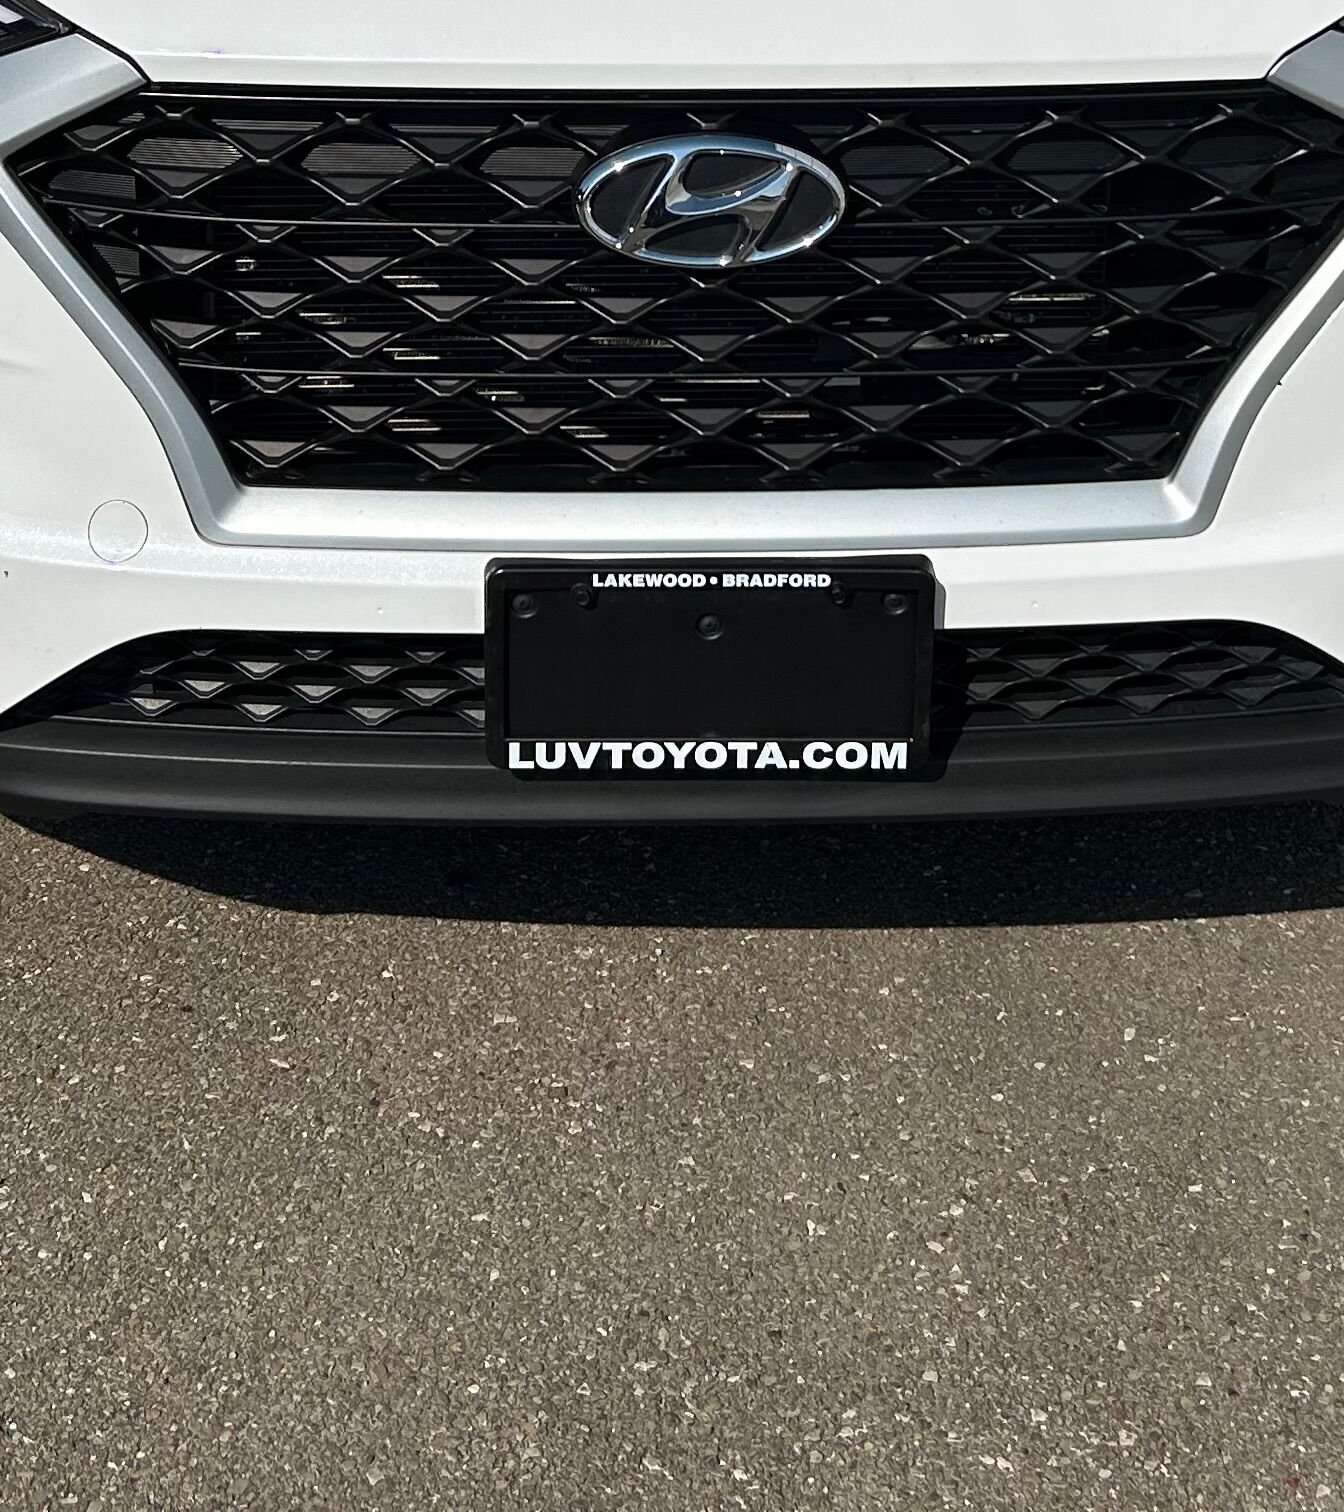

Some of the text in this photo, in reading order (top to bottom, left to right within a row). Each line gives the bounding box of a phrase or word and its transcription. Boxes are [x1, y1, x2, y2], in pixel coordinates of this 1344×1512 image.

[592, 573, 832, 588] LAKEWOOD BRADFORD
[507, 740, 908, 770] LUVTOYOTA.COM
